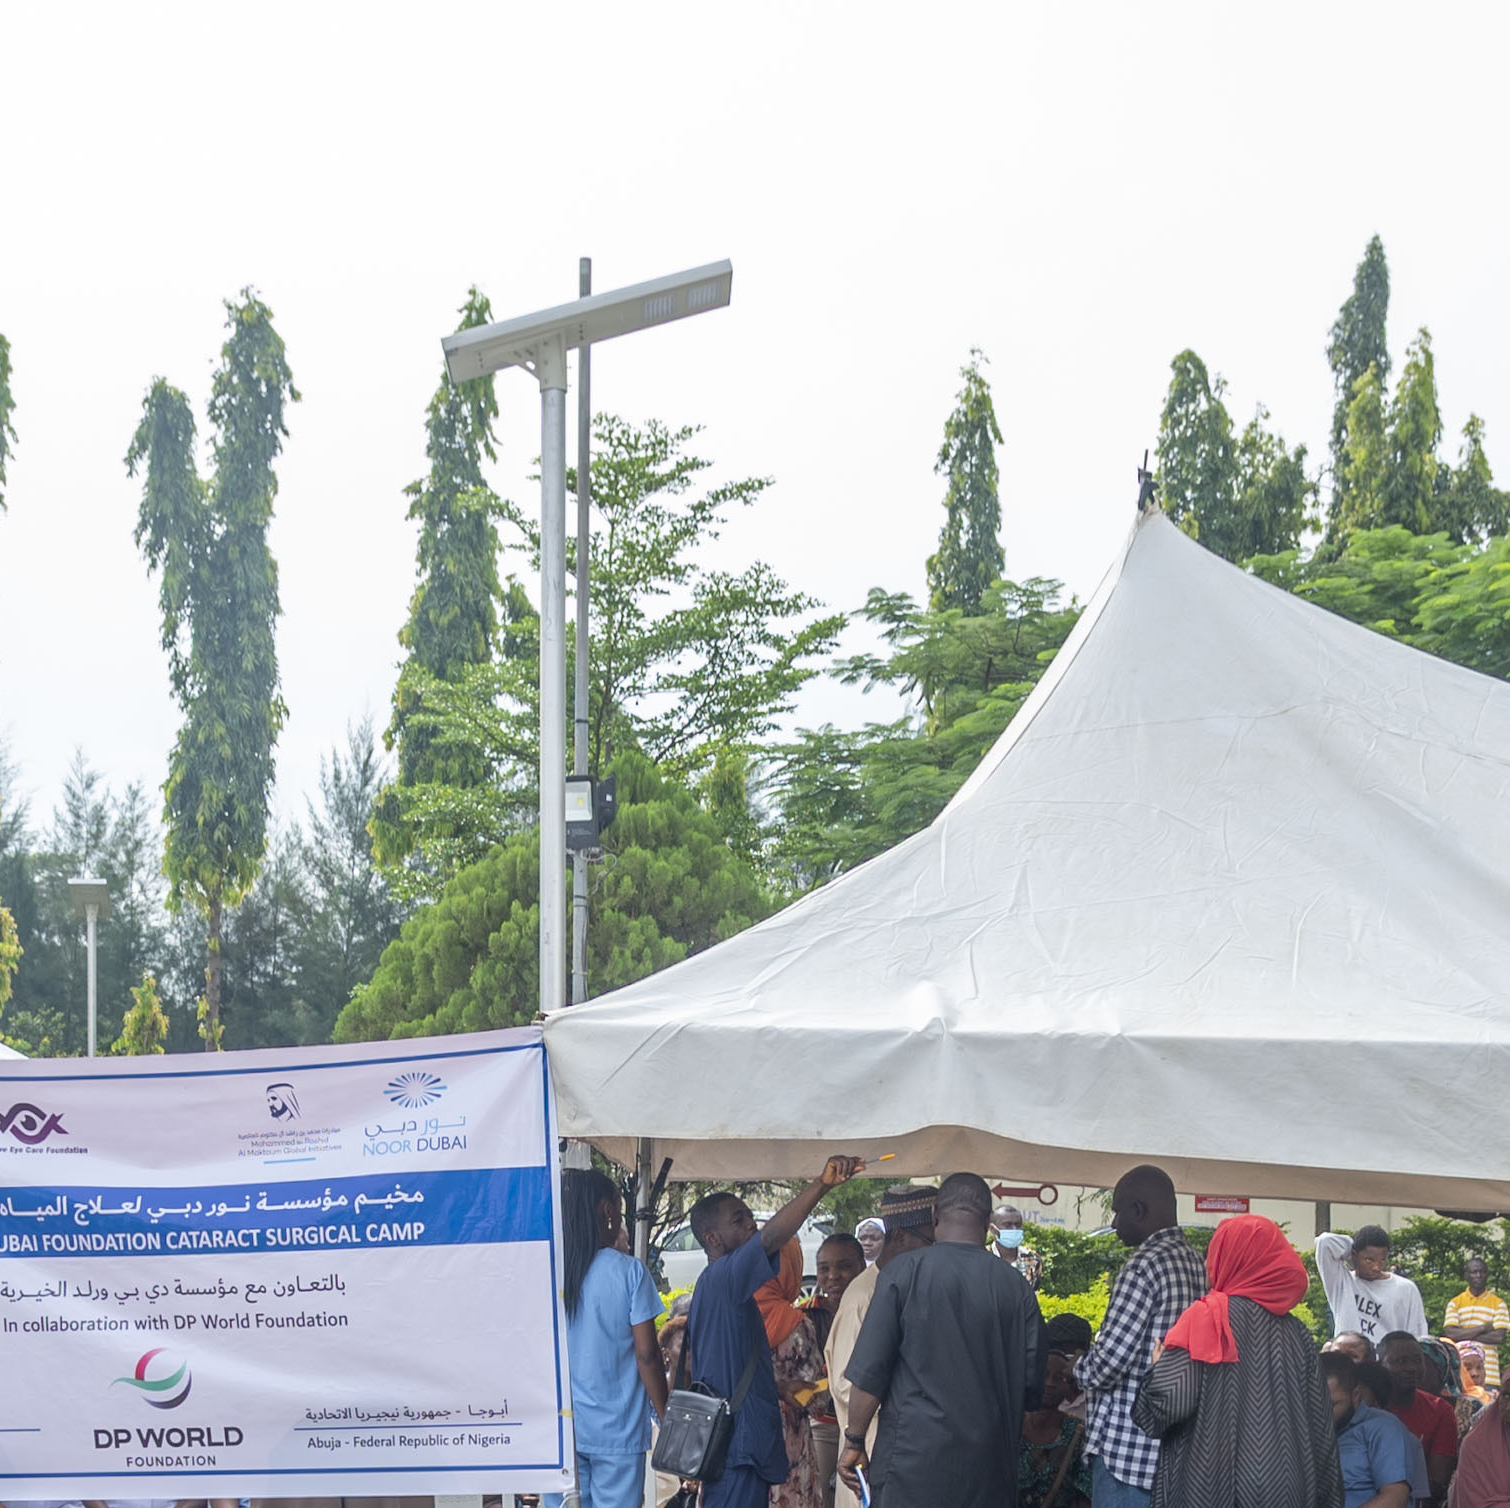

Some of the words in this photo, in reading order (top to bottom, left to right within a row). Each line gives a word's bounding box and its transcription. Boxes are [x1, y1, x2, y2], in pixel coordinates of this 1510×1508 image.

[364, 1119, 417, 1143] دبي
[420, 1115, 466, 1136] نور
[9, 1146, 23, 1154] Eye
[25, 1146, 44, 1154] Care
[46, 1146, 89, 1154] Foundation
[362, 1139, 411, 1157] NOOR
[416, 1135, 467, 1152] DUBAI
[0, 1195, 68, 1222] المياه
[205, 1195, 251, 1217] نور
[256, 1188, 348, 1212] مؤسسة
[354, 1184, 425, 1214] مخيم
[73, 1195, 142, 1226] لعلاج
[147, 1200, 203, 1224] دبي
[42, 1231, 161, 1252] FOUNDATION
[165, 1228, 261, 1250] CATARACT
[265, 1224, 361, 1246] SURGICAL
[365, 1221, 425, 1242] CAMP
[0, 1280, 67, 1303] الخيرية
[72, 1279, 109, 1300] ورلد
[113, 1284, 140, 1306] بي
[145, 1283, 170, 1304] دي
[173, 1277, 239, 1298] مؤسسة
[244, 1282, 268, 1304] مع
[273, 1273, 346, 1297] بالتعاون
[3, 1316, 18, 1333] In
[22, 1315, 129, 1333] collaboration
[133, 1314, 169, 1331] with
[174, 1314, 196, 1330] DP
[202, 1312, 251, 1330] World
[255, 1310, 349, 1329] Foundation
[305, 1407, 352, 1422] الاتحادية
[355, 1406, 400, 1422] نيجيريا
[403, 1406, 452, 1421] جمهورية
[468, 1398, 509, 1419] أبوجا
[93, 1428, 132, 1449] DP
[136, 1426, 244, 1448] WORLD
[307, 1436, 341, 1451] Abuja
[353, 1434, 395, 1448] Federal
[399, 1433, 449, 1449] Republic
[452, 1433, 465, 1446] of
[468, 1432, 511, 1448] Nigeria
[126, 1455, 217, 1467] FOUNDATION
